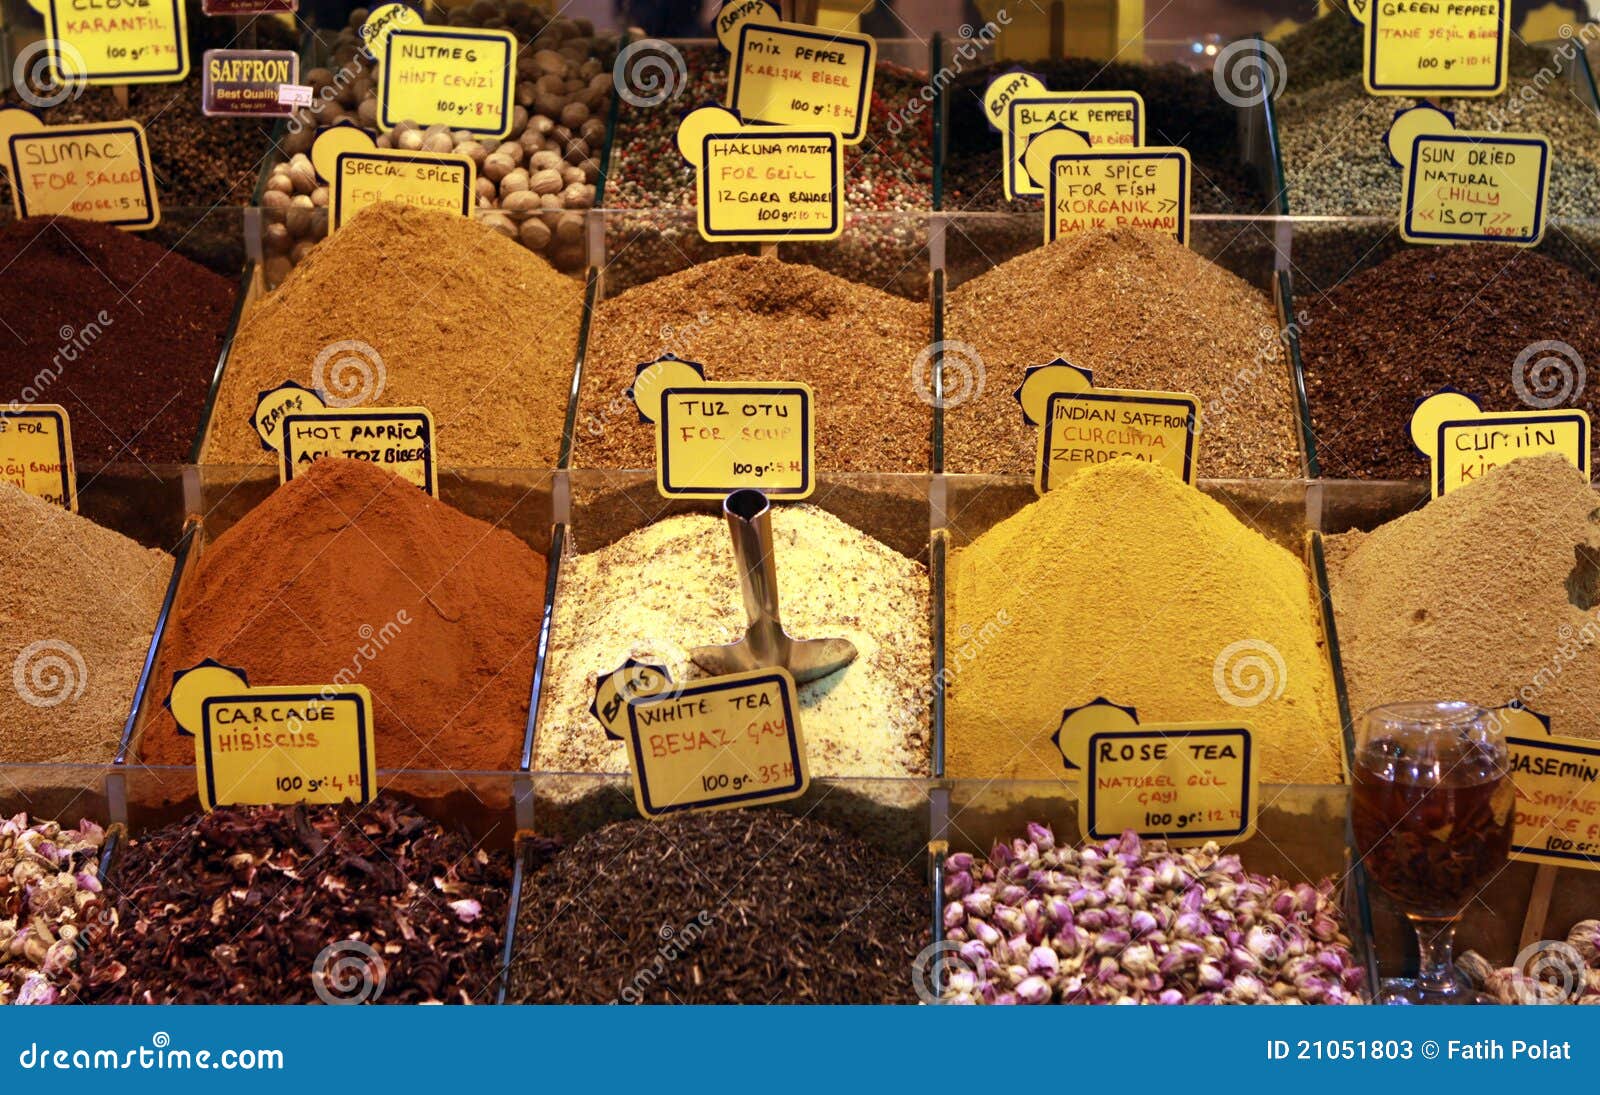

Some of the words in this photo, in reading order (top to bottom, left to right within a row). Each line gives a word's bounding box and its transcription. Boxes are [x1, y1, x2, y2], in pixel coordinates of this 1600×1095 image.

[1382, 2, 1439, 16] GREEN
[1448, 4, 1497, 16] PEPPER
[107, 46, 126, 58] 100
[402, 45, 478, 62] NUTMEG
[795, 46, 847, 65] PEPPER
[210, 60, 289, 82] SAFFRON
[1418, 57, 1438, 69] 100
[217, 89, 241, 99] Best
[243, 89, 279, 101] Quality
[437, 100, 455, 112] 100
[791, 99, 809, 112] 100
[1021, 109, 1079, 125] BLACK
[1088, 110, 1134, 122] PEPPER
[26, 142, 120, 165] SUMAC
[714, 143, 782, 157] HAKUNA
[1422, 147, 1455, 163] SUN
[32, 171, 77, 191] FOR
[86, 170, 141, 187] SALAD
[721, 166, 758, 180] FOR
[1424, 170, 1498, 187] NATURAL
[789, 191, 832, 203] BAHARI
[1069, 183, 1106, 197] FOR
[71, 200, 92, 213] 100
[1483, 226, 1502, 236] 100
[680, 401, 729, 417] TUZ
[742, 404, 788, 417] OTU
[18, 422, 48, 434] FOR
[1121, 412, 1189, 429] SAFFRON
[297, 426, 341, 439] HOT
[680, 427, 725, 442] FOR
[741, 427, 792, 441] SOUP
[1064, 427, 1166, 449] CURCUMA
[733, 462, 752, 475] 100
[729, 693, 771, 711] TEA
[650, 728, 736, 758] BEYAZ
[1100, 742, 1168, 763] ROSE
[1189, 745, 1237, 760] TEA
[277, 776, 302, 791] 100
[702, 775, 728, 792] 100
[1098, 775, 1176, 791] NATUREL
[1145, 812, 1171, 827] 100
[1208, 810, 1224, 821] 12
[1546, 835, 1573, 851] 100
